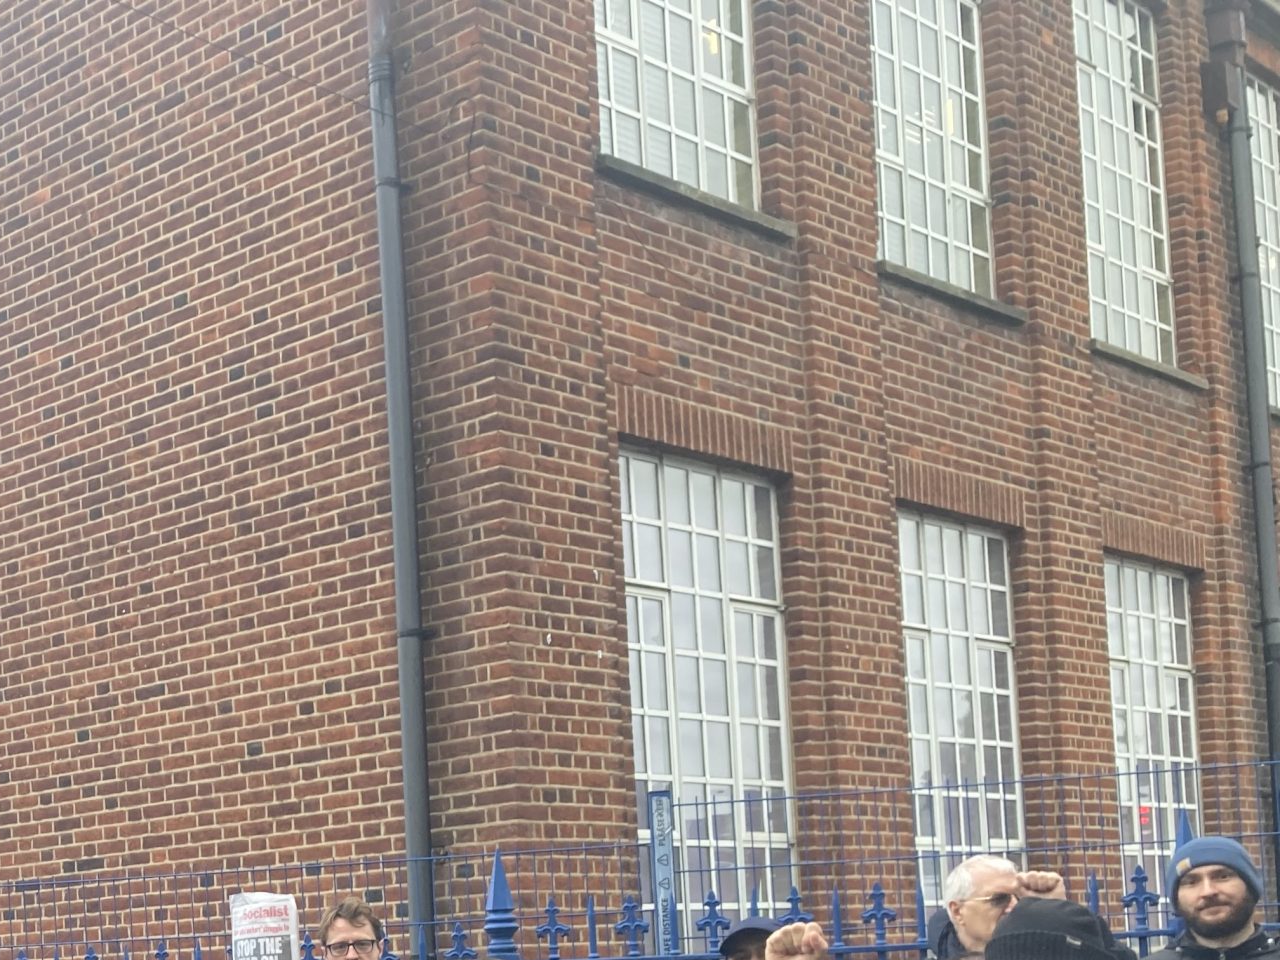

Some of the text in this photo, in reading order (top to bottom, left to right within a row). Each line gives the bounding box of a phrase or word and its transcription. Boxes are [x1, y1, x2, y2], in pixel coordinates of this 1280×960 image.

[661, 897, 671, 936] DISTANCE
[237, 936, 283, 957] STOP THE
